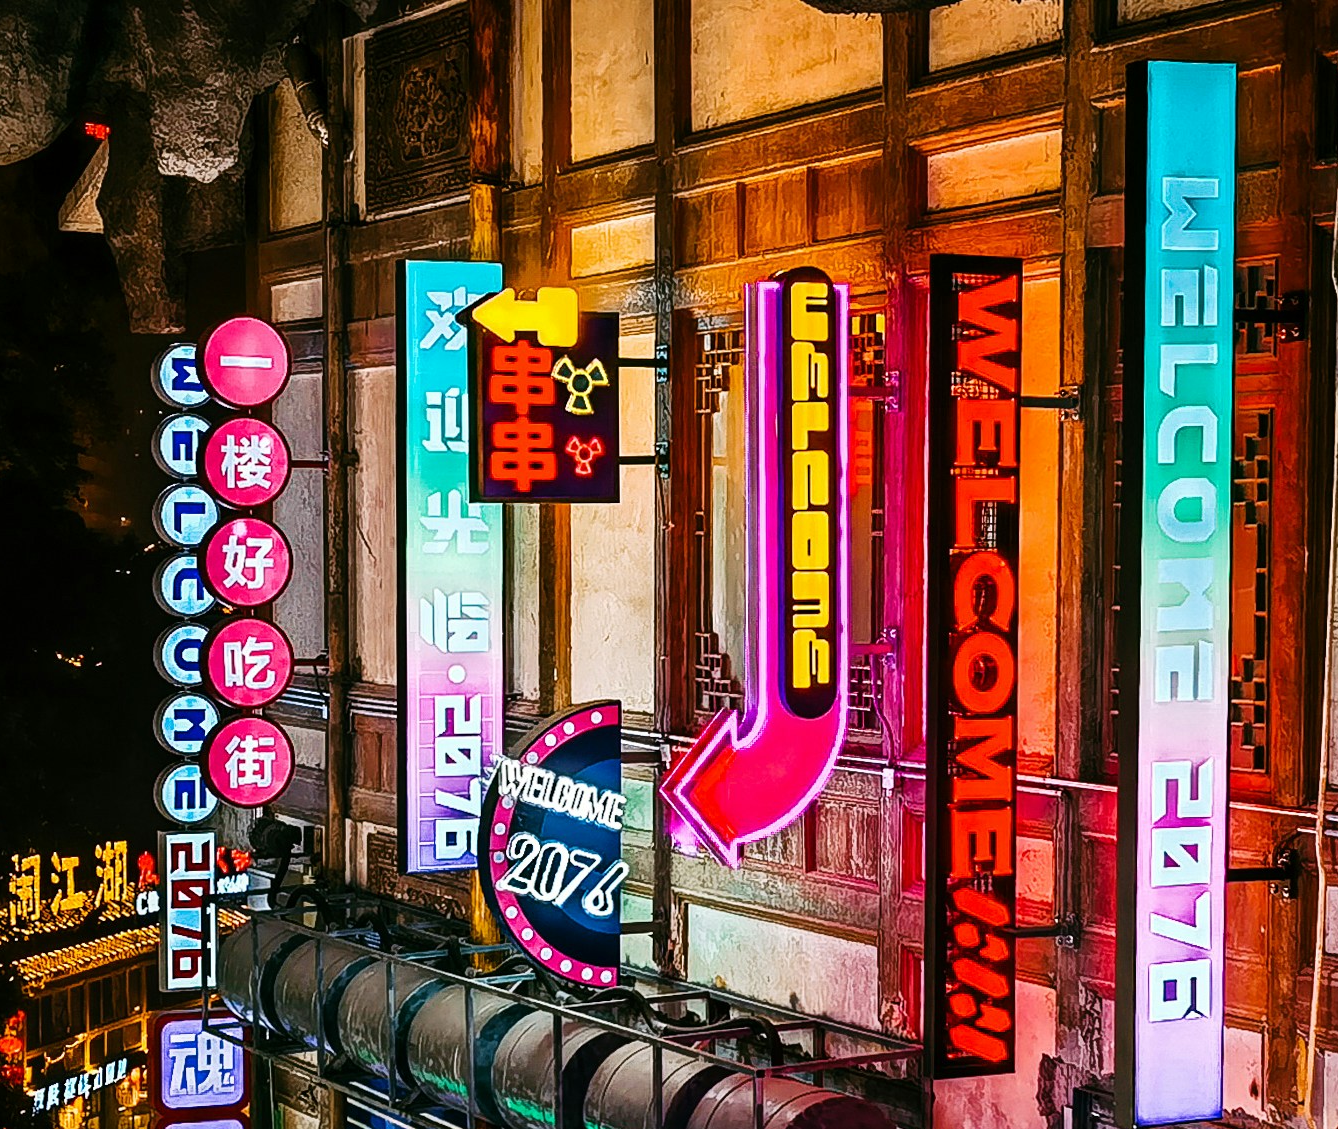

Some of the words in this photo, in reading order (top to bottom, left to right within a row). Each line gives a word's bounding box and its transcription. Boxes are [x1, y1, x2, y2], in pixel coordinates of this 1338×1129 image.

[489, 339, 559, 493] 串串
[1155, 173, 1220, 706] WELCOME
[218, 353, 276, 788] 一楼好吃街
[491, 754, 628, 831] WELCOME
[495, 830, 630, 918] 2076
[1147, 755, 1214, 1025] 2076
